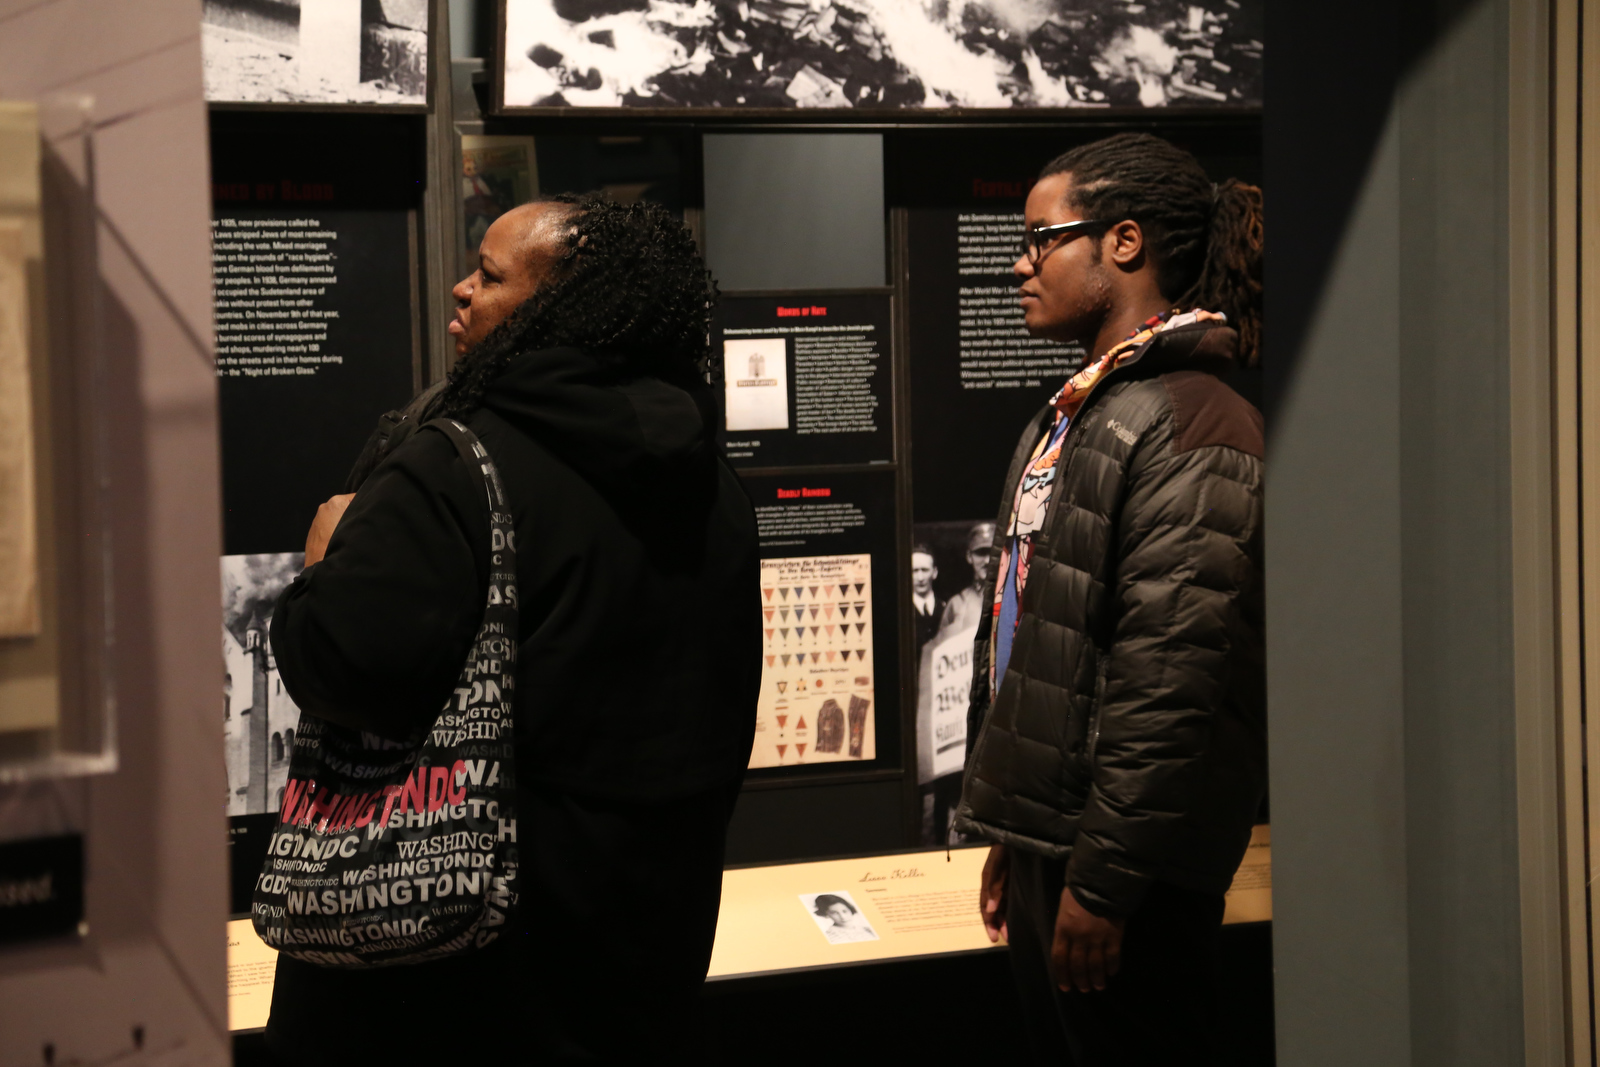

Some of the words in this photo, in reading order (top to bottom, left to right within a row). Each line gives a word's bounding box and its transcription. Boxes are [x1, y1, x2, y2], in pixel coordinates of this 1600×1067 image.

[256, 184, 275, 200] BY
[281, 180, 334, 200] BLOOD
[221, 219, 237, 228] 1935,
[254, 219, 287, 228] provisions
[288, 218, 308, 226] called
[309, 218, 320, 226] the
[233, 230, 260, 240] stripped
[261, 230, 279, 238] Jews
[280, 230, 287, 238] of
[288, 230, 304, 238] most
[305, 230, 337, 239] remaining
[244, 242, 254, 250] the
[273, 241, 293, 249] Mixed
[294, 241, 327, 251] marriages
[237, 253, 248, 261] the
[250, 253, 276, 263] grounds
[277, 253, 284, 261] of
[275, 264, 290, 272] from
[291, 264, 325, 272] defilement
[326, 264, 334, 273] by
[254, 276, 261, 284] In
[279, 275, 308, 285] Germany
[309, 275, 337, 283] annexed
[217, 287, 247, 297] occupied
[249, 287, 259, 295] the
[261, 287, 301, 295] Sudetenland
[318, 286, 325, 295] of
[974, 286, 991, 294] World
[992, 286, 1003, 294] War
[230, 299, 255, 307] without
[256, 299, 279, 308] protest
[280, 298, 295, 306] from
[296, 298, 314, 306] other
[968, 297, 986, 307] people
[1002, 297, 1012, 305] and
[245, 310, 255, 318] On
[256, 310, 289, 318] November
[302, 310, 309, 318] of
[310, 309, 323, 317] that
[776, 306, 800, 316] WORDS
[802, 308, 810, 316] OF
[811, 306, 827, 316] HATE
[230, 321, 248, 329] mobs
[249, 321, 255, 329] in
[257, 321, 274, 329] cities
[299, 321, 328, 331] Germany
[219, 333, 242, 341] burned
[267, 332, 274, 340] of
[275, 334, 313, 342] synagogues
[314, 332, 327, 340] and
[960, 328, 977, 336] blame
[960, 339, 971, 347] two
[972, 339, 992, 347] months
[253, 344, 286, 354] murdering
[287, 344, 307, 353] nearly
[961, 349, 970, 357] the
[1018, 348, 1034, 356] dozen
[1034, 347, 1071, 355] concentration
[227, 355, 238, 363] the
[239, 355, 261, 363] streets
[263, 355, 275, 363] and
[276, 355, 282, 363] in
[283, 355, 298, 363] their
[299, 355, 321, 363] homes
[322, 355, 343, 364] during
[961, 359, 978, 367] would
[979, 359, 1002, 368] imprison
[1003, 358, 1023, 368] political
[229, 367, 240, 376] the
[264, 367, 271, 375] of
[272, 366, 295, 375] Broken
[961, 370, 990, 379] Witnesses,
[991, 369, 1026, 377] homosexuals
[1027, 369, 1038, 377] and
[1043, 369, 1062, 378] special
[777, 488, 801, 498] DEADLY
[802, 487, 831, 497] RAINBOW
[266, 916, 430, 948] WASHINGTONDC
